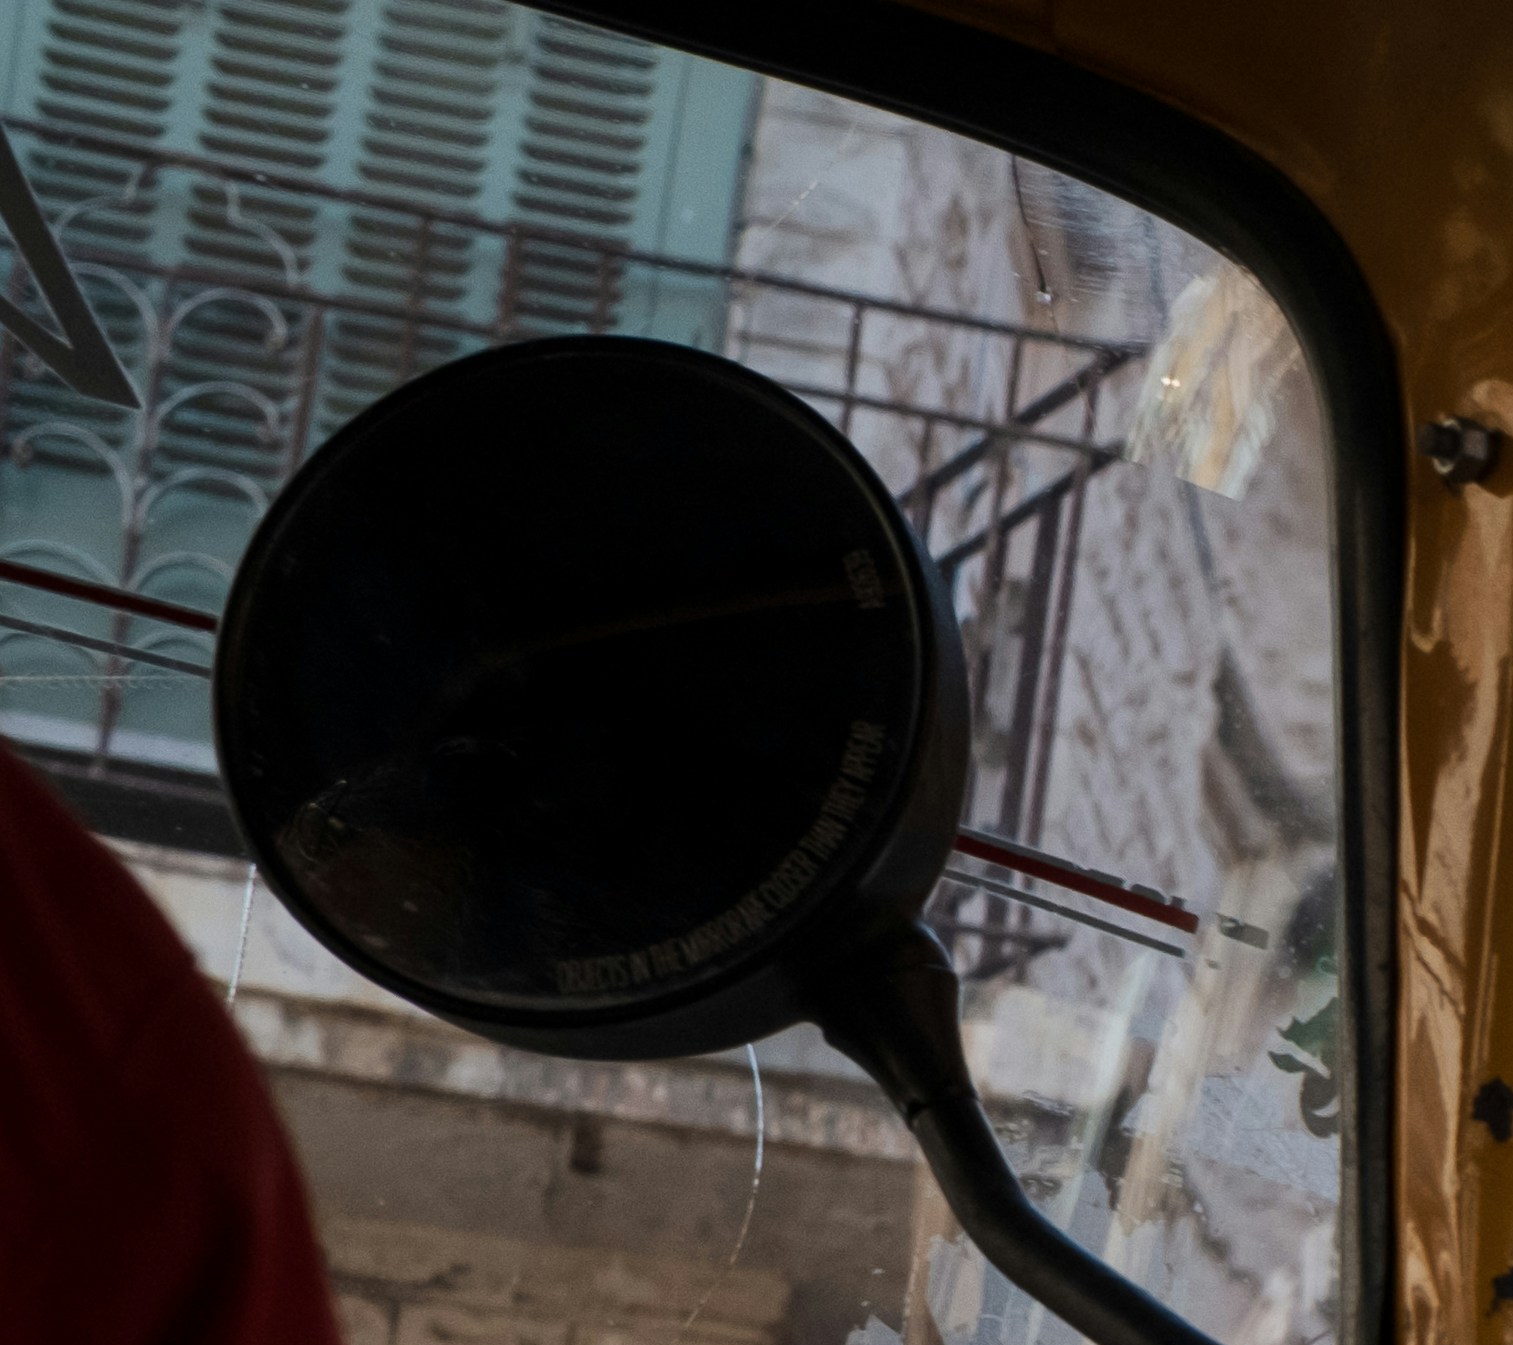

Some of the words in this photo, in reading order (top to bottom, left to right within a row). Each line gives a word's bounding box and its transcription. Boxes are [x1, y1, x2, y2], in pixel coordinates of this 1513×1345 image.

[841, 720, 886, 782] APPEAR
[821, 777, 867, 822] THEY
[800, 816, 849, 861] THAN
[759, 850, 818, 908] CLOSER
[737, 890, 777, 930] ARE
[650, 941, 682, 976] THE
[682, 909, 746, 965] MIRROR
[559, 956, 627, 994] OBJECTS
[631, 952, 649, 983] IN
